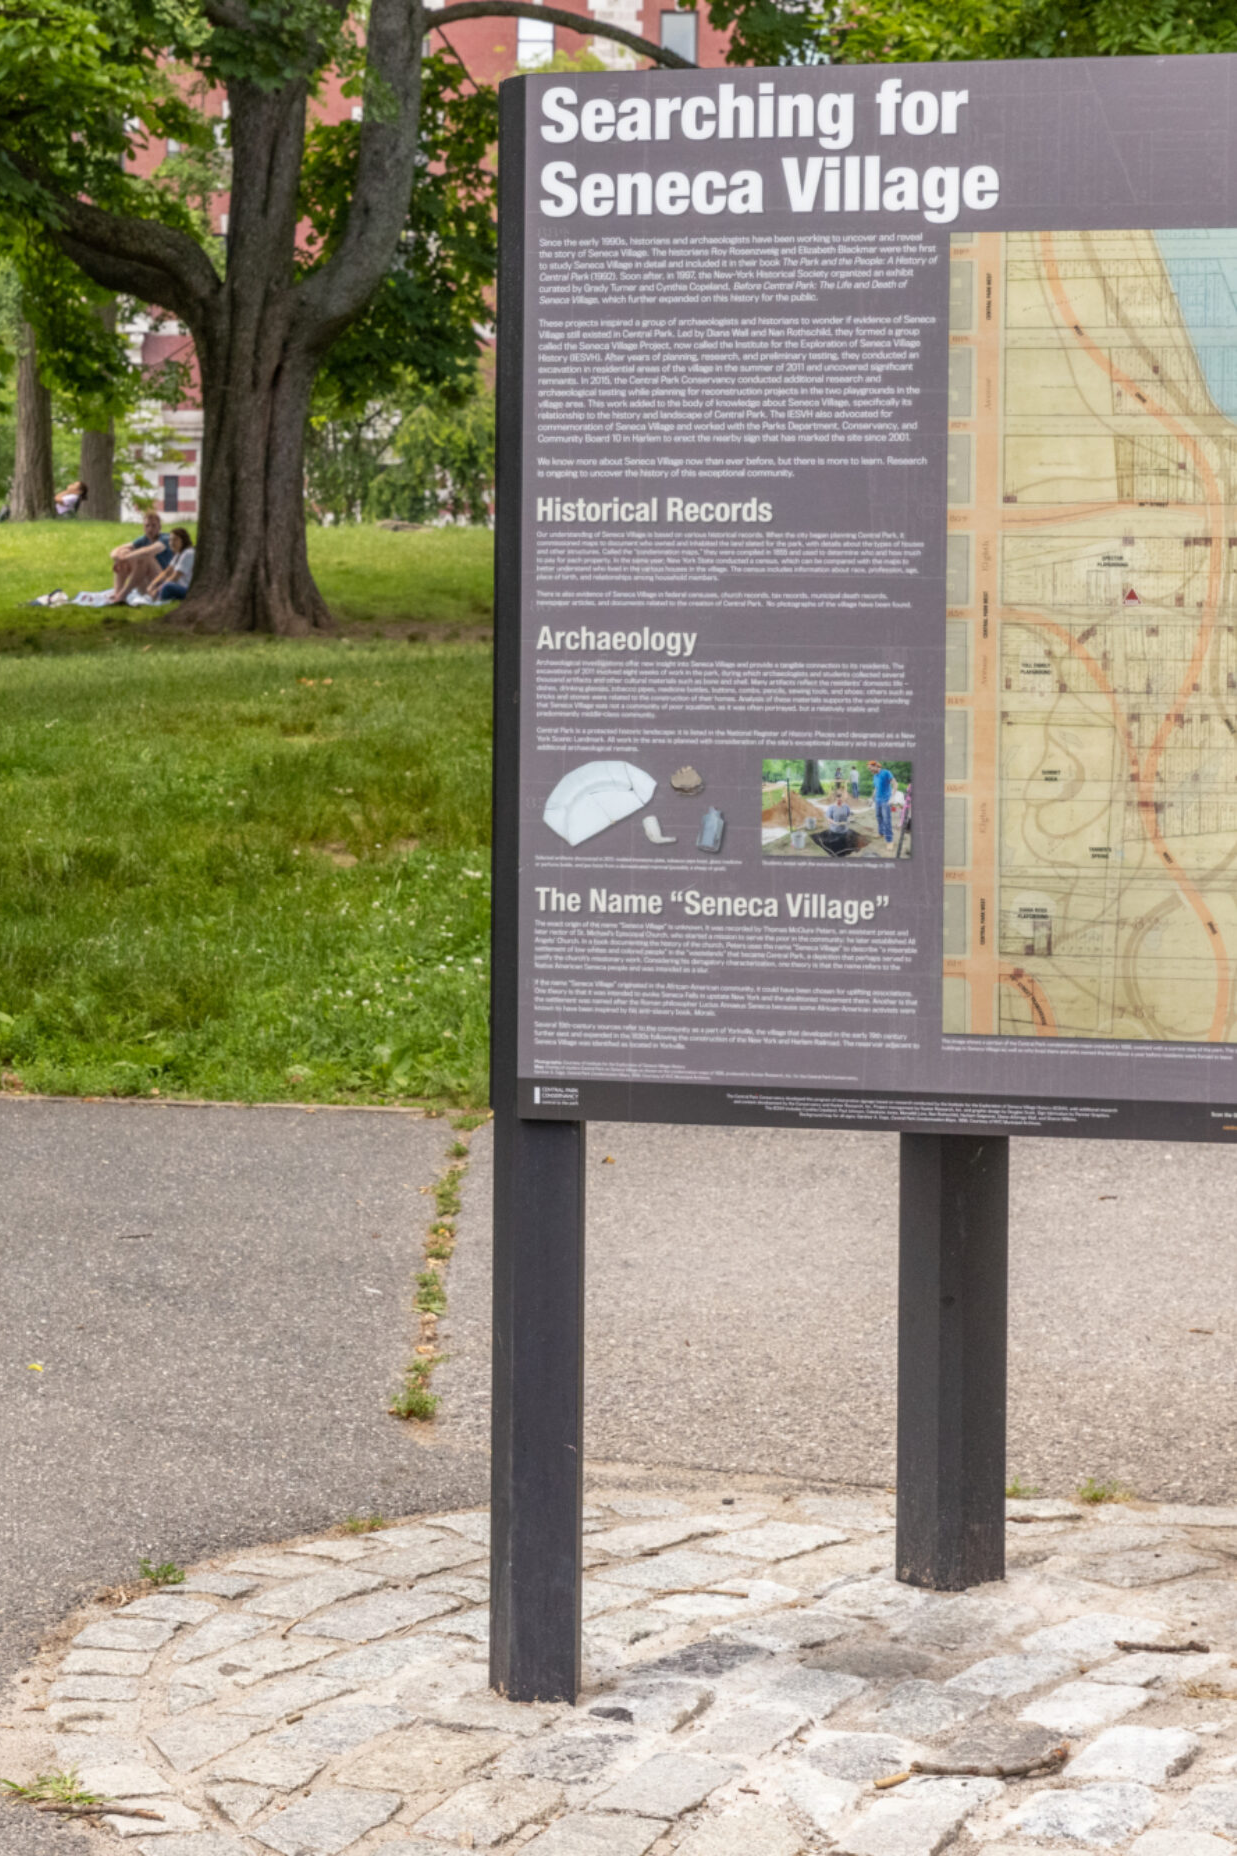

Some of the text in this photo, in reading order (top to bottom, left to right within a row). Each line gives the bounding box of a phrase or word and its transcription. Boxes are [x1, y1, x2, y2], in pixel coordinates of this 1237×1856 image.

[540, 77, 969, 150] Searching for
[539, 155, 1000, 224] Seneca Village
[538, 237, 562, 247] Since
[563, 237, 577, 246] the
[578, 237, 599, 248] early
[629, 235, 670, 245] historians
[672, 235, 688, 245] and
[689, 234, 750, 246] archaeologists
[751, 234, 772, 243] have
[773, 233, 795, 243] been
[796, 233, 830, 245] working
[831, 233, 840, 242] to
[842, 234, 876, 242] uncover
[878, 232, 895, 241] and
[896, 231, 923, 241] reveal
[538, 249, 552, 258] the
[554, 248, 575, 260] story
[577, 248, 586, 257] of
[587, 248, 619, 257] Seneca
[651, 247, 666, 256] The
[668, 246, 709, 256] historians
[710, 246, 727, 257] Roy
[780, 245, 796, 254] and
[879, 245, 901, 253] were
[902, 243, 917, 252] the
[918, 243, 936, 252] first
[538, 260, 547, 269] to
[549, 260, 572, 271] study
[573, 259, 604, 269] Seneca
[606, 259, 633, 270] Village
[634, 259, 642, 268] in
[643, 258, 666, 268] detail
[667, 258, 683, 268] and
[685, 258, 720, 267] included
[721, 258, 727, 267] it
[728, 257, 736, 267] in
[737, 257, 757, 267] their
[758, 257, 780, 266] book
[783, 256, 798, 266] The
[799, 256, 818, 266] Park
[820, 256, 837, 265] and
[838, 256, 852, 265] the
[886, 255, 893, 264] A
[895, 255, 927, 266] History
[927, 254, 938, 264] of
[538, 271, 569, 281] Central
[570, 271, 588, 281] Park
[619, 270, 641, 280] Soon
[666, 270, 674, 279] in
[697, 269, 712, 279] the
[755, 268, 795, 278] Historical
[797, 268, 828, 279] Society
[830, 267, 871, 279] organized
[873, 268, 884, 276] an
[885, 266, 914, 276] exhibit
[538, 283, 570, 292] curated
[571, 283, 582, 294] by
[583, 282, 608, 294] Grady
[610, 282, 636, 292] Turner
[638, 282, 654, 291] and
[732, 280, 762, 290] Before
[762, 280, 794, 290] Central
[819, 279, 835, 289] The
[836, 279, 852, 289] Life
[853, 279, 870, 288] and
[871, 278, 896, 288] Death
[897, 278, 908, 288] of
[538, 294, 570, 304] Seneca
[601, 294, 626, 303] which
[627, 293, 656, 303] further
[658, 293, 699, 305] expanded
[700, 294, 711, 302] on
[712, 292, 728, 302] this
[729, 292, 759, 304] history
[761, 292, 773, 301] for
[775, 292, 789, 301] the
[538, 314, 936, 329] These projects inspired a group of archaeologists and historians to wonder if evidence of Seneca
[536, 468, 544, 477] is
[545, 468, 577, 479] ongoing
[579, 468, 588, 477] to
[589, 469, 622, 477] uncover
[624, 468, 638, 477] the
[639, 468, 668, 479] history
[670, 468, 679, 477] of
[680, 467, 696, 477] this
[697, 467, 745, 479] exceptional
[536, 496, 773, 523] Historical Records
[535, 625, 698, 657] Archaeology
[534, 886, 890, 925] The Name “Seneca Village”
